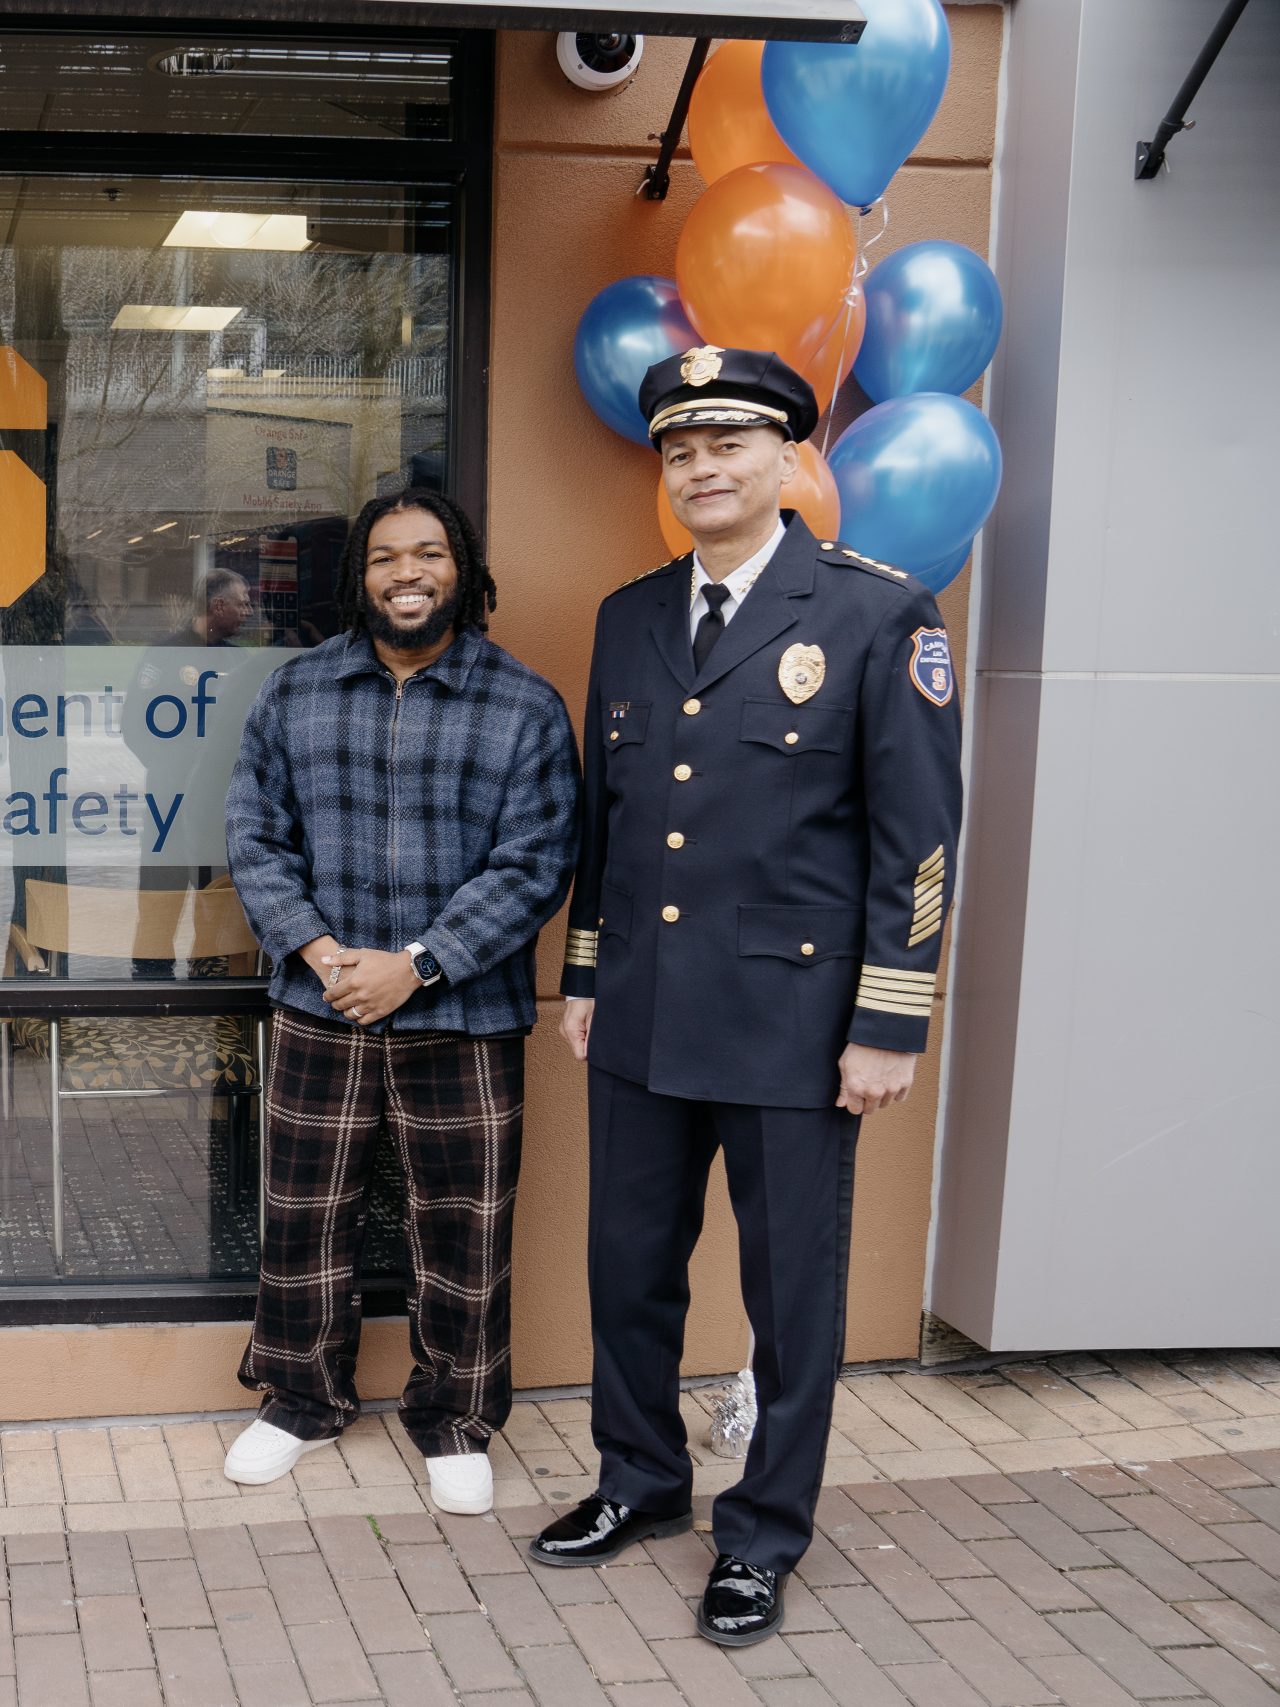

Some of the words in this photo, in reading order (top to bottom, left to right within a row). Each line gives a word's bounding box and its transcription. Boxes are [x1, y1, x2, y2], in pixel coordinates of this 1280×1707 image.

[255, 425, 287, 441] Orange
[289, 427, 309, 440] Safe
[268, 470, 296, 479] ORANGE
[272, 479, 291, 488] SAFE
[924, 641, 947, 653] CAMP
[932, 668, 946, 690] S
[144, 670, 218, 738] of
